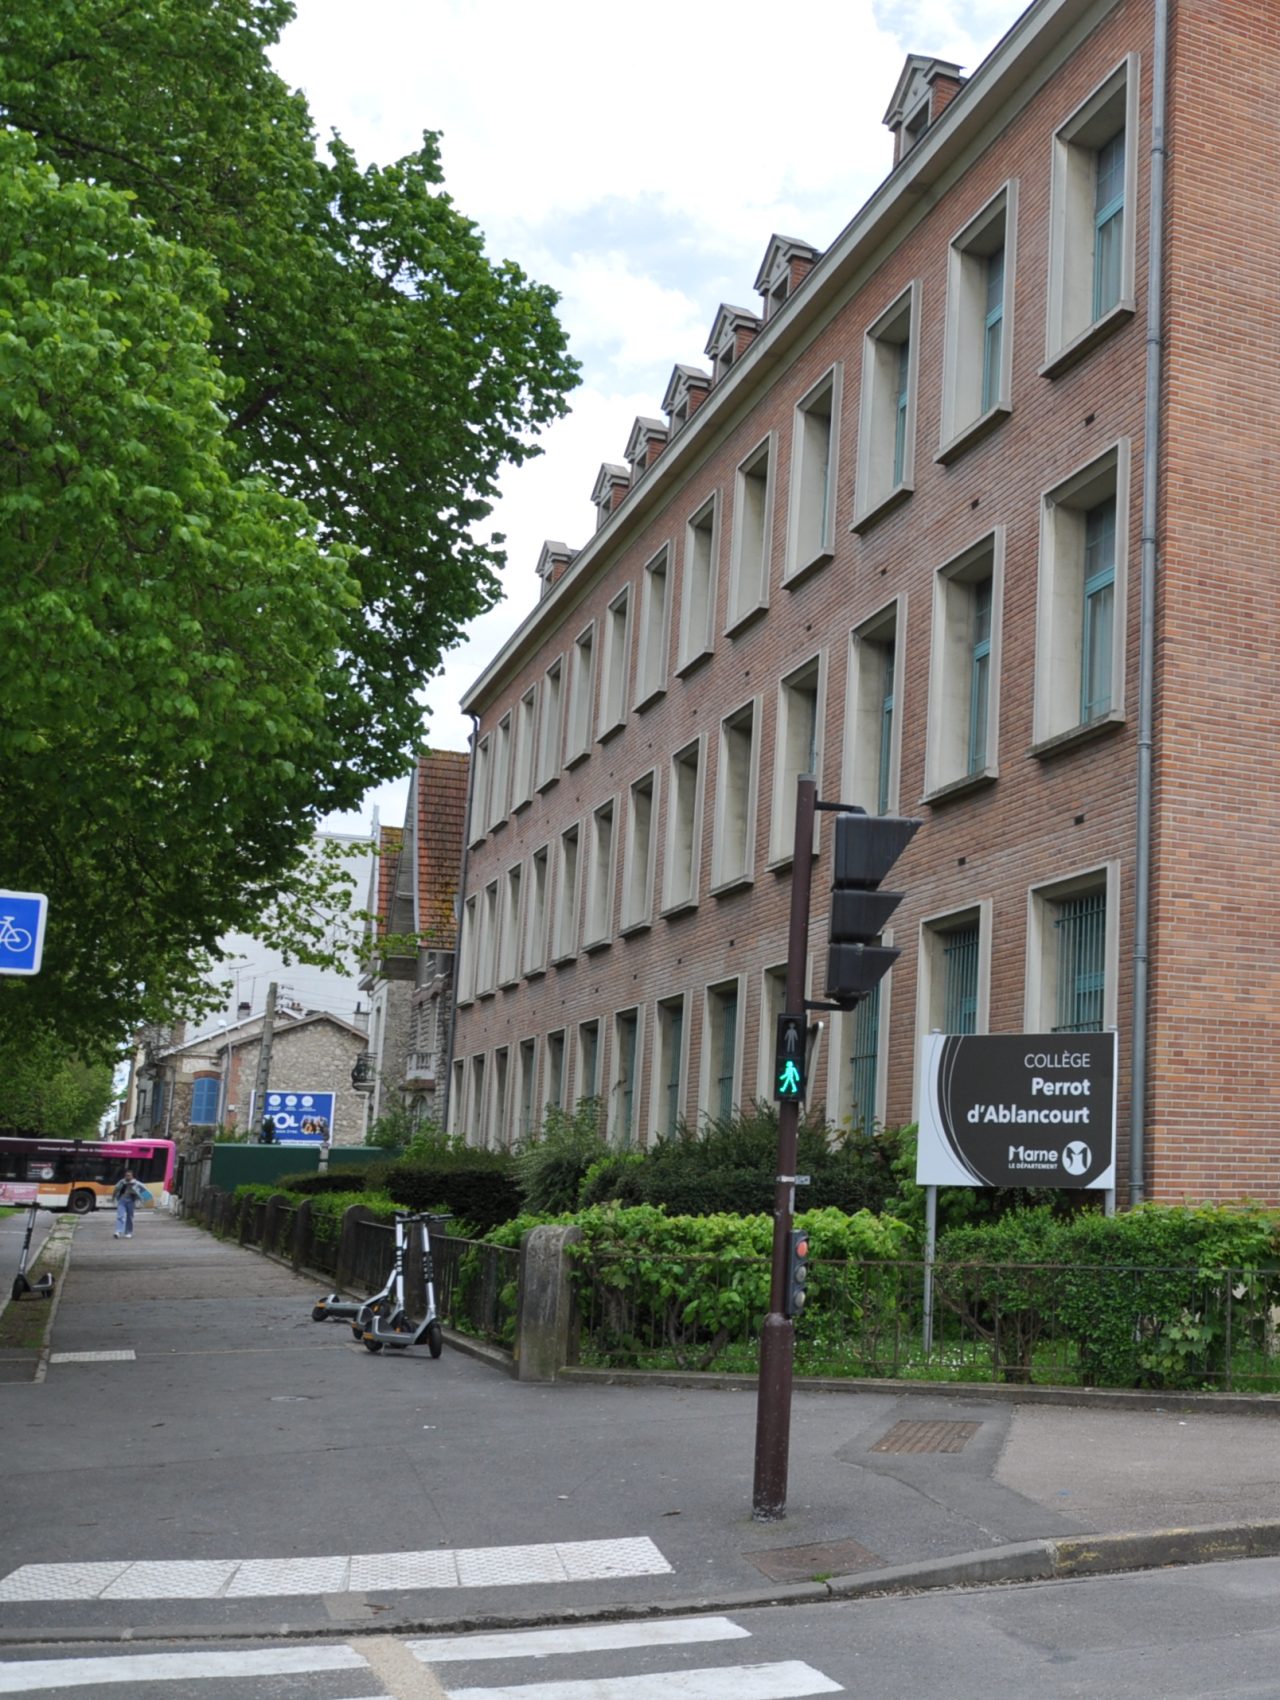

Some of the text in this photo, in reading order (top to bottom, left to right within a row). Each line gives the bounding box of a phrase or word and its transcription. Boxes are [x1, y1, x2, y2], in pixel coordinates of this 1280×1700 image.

[1024, 1051, 1091, 1068] COLLÈGE
[1031, 1077, 1091, 1096] Perrot
[967, 1104, 1090, 1124] d'Ablancourt
[1008, 1145, 1059, 1162] Marne
[1016, 1161, 1058, 1169] DÉPARTEMENT
